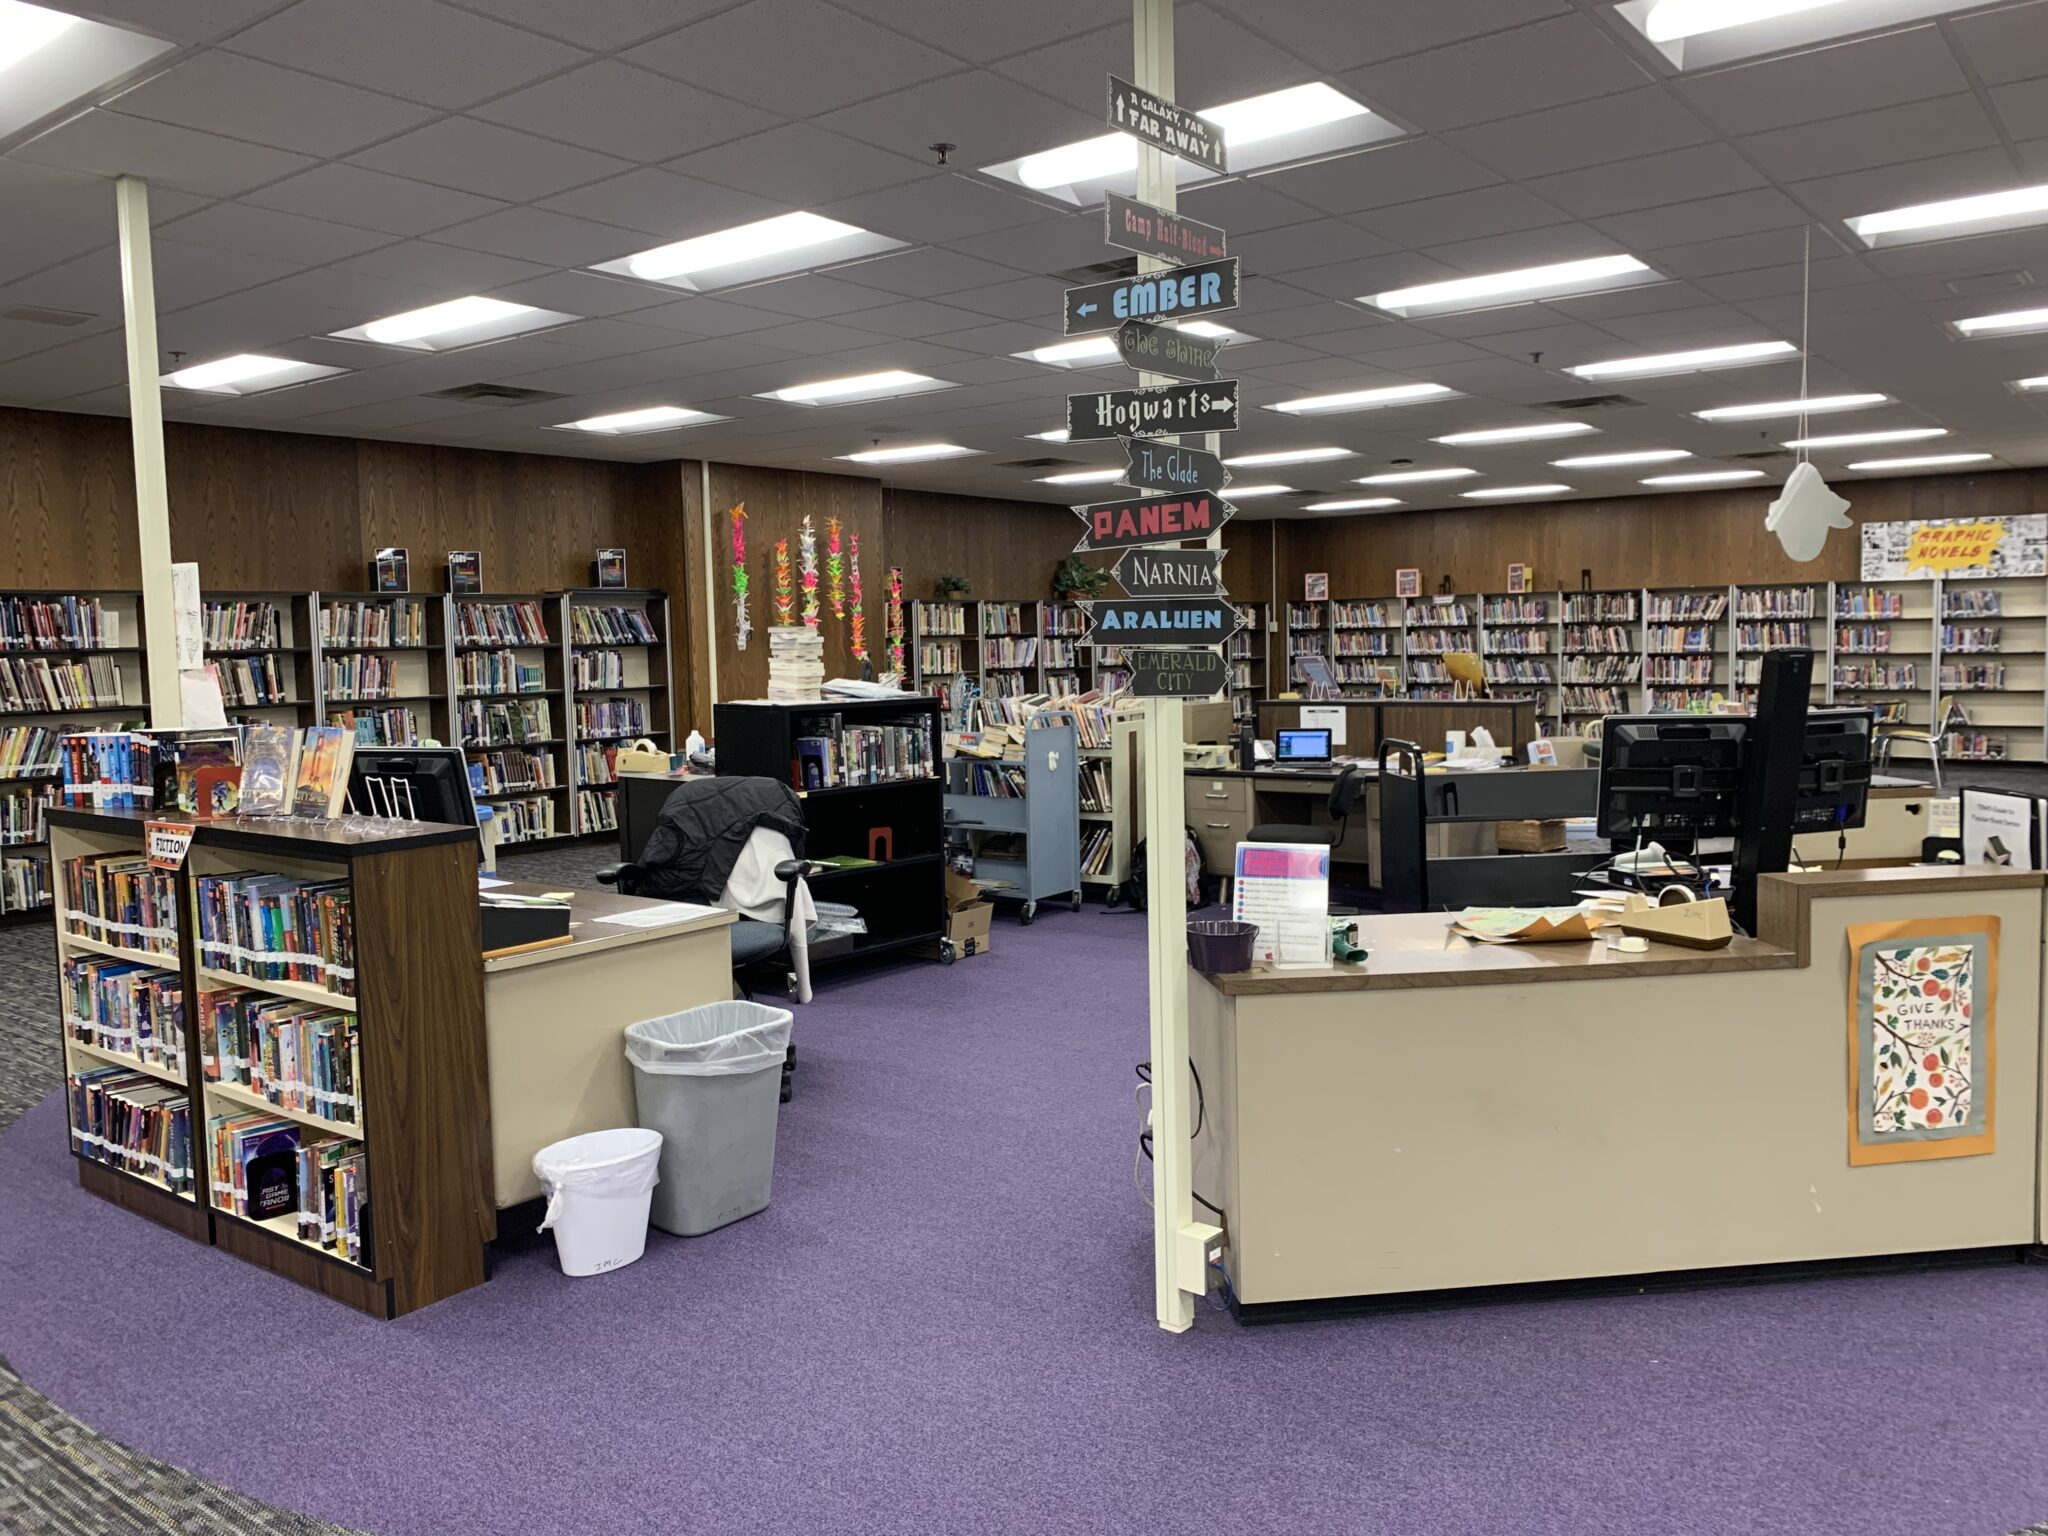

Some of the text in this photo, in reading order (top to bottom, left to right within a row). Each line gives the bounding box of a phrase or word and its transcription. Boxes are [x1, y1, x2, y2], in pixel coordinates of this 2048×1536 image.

[1131, 92, 1208, 140] A GALAXY, FAR,
[1129, 108, 1210, 159] FAR AWAY
[1125, 208, 1207, 255] Camp Half-Blood
[1113, 272, 1221, 319] EMBER
[1124, 328, 1159, 356] The
[1095, 388, 1211, 433] Hogwarts
[1141, 449, 1198, 484] The Glade
[1093, 499, 1210, 540] PANEM
[1918, 529, 1993, 543] GRAPHIC
[1918, 545, 1982, 559] NOVELS
[1133, 556, 1213, 587] NARNIA
[1101, 609, 1222, 630] ARALUEN
[1137, 652, 1217, 672] EMERALD
[1157, 672, 1194, 691] CITY
[156, 837, 186, 854] FICTION
[1897, 1003, 1934, 1016] GIVE
[1903, 1018, 1955, 1031] THANKS
